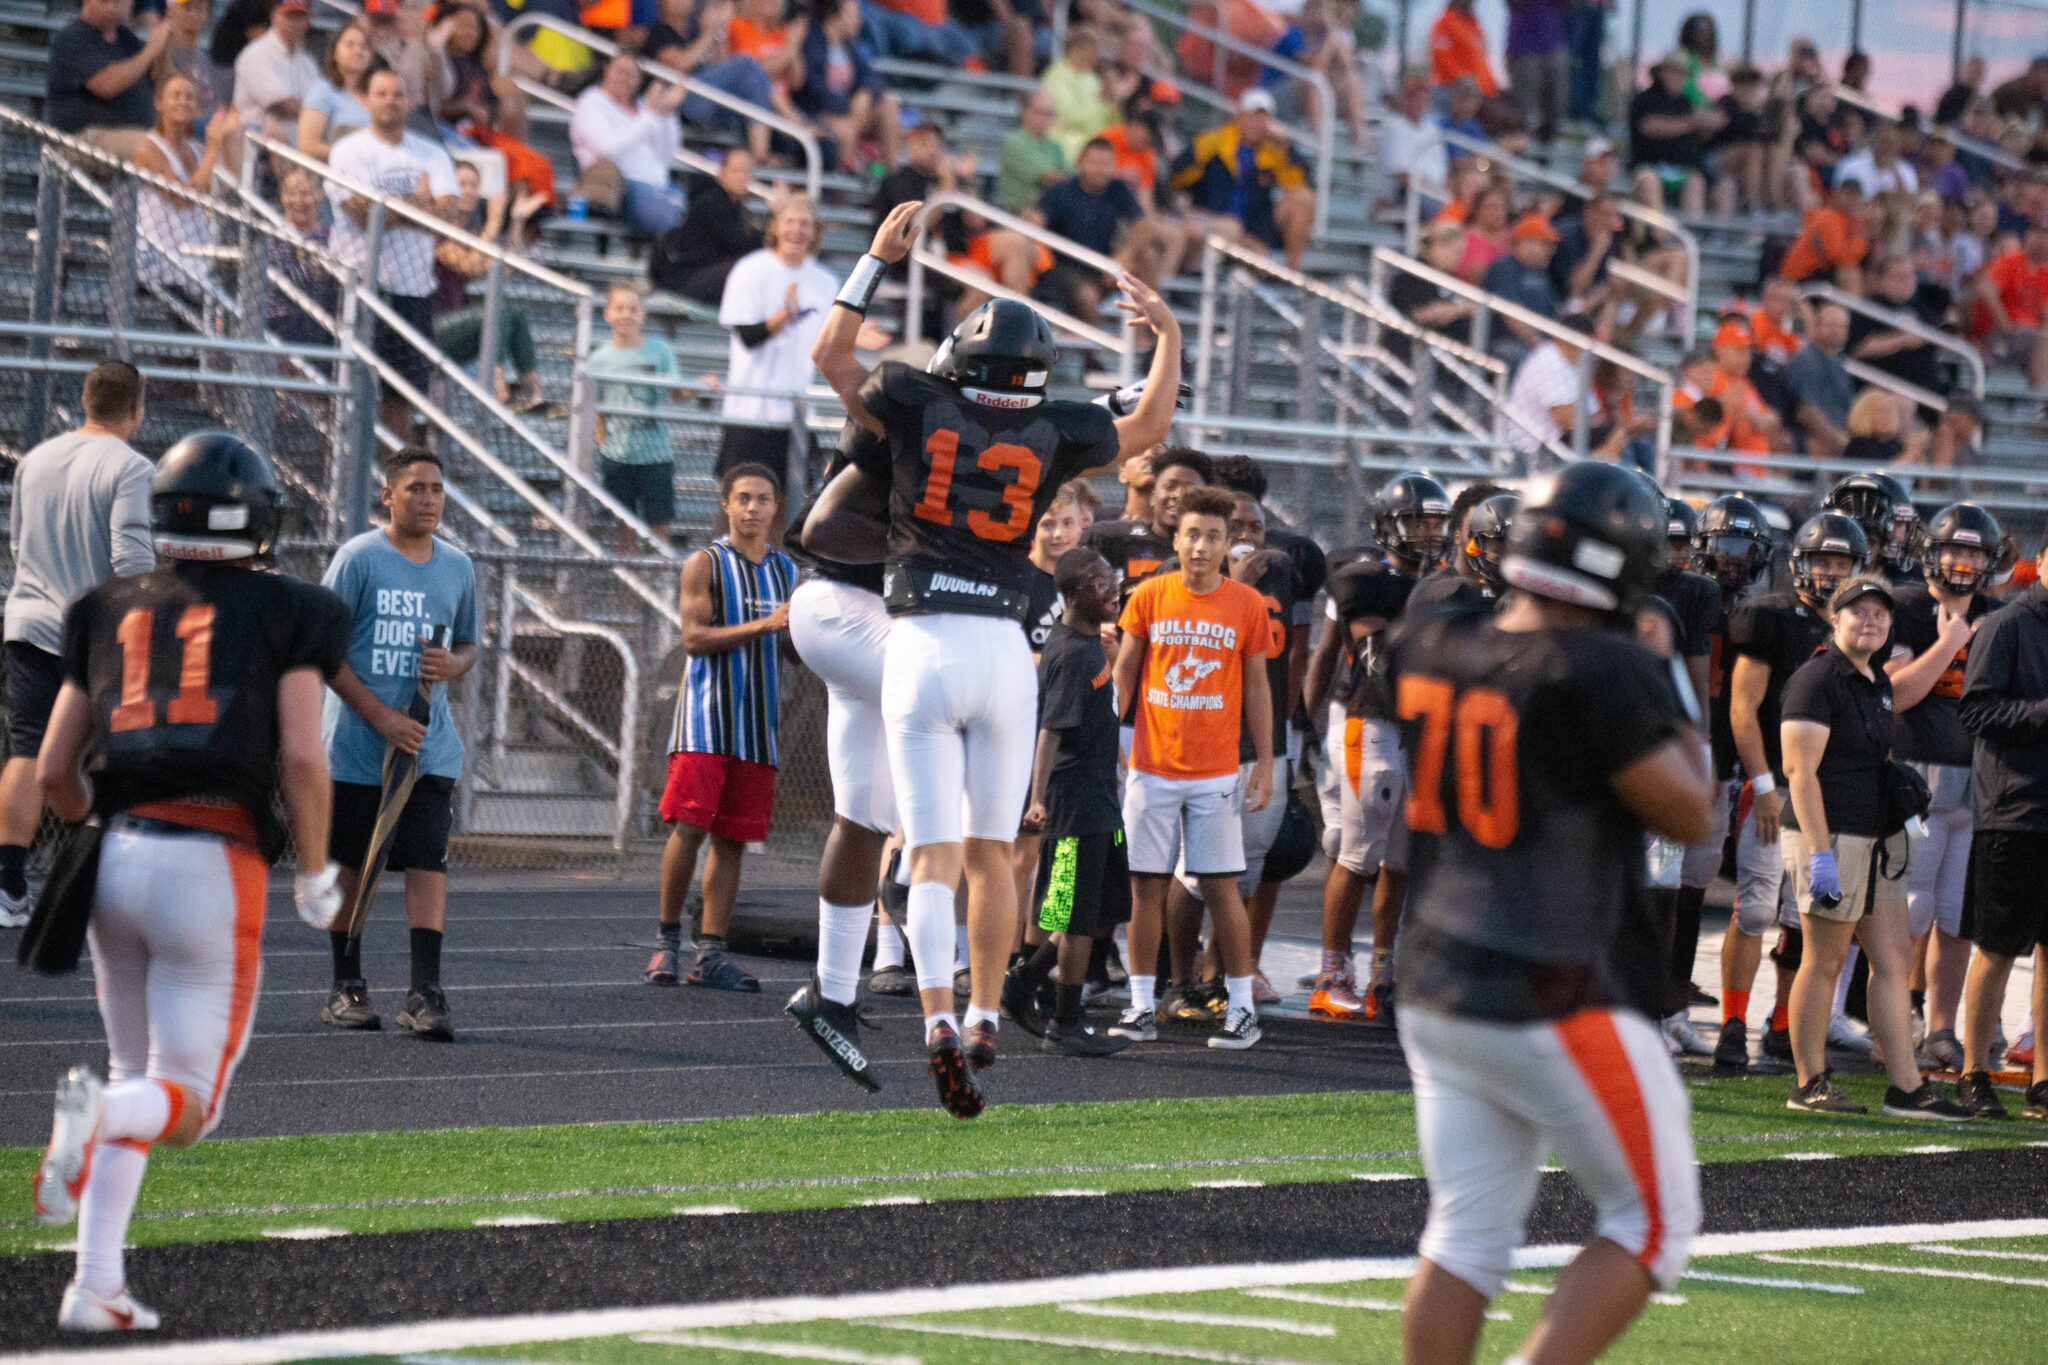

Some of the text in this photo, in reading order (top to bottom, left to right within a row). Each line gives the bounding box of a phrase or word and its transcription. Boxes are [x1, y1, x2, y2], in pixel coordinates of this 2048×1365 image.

[976, 392, 1029, 409] Riddell
[914, 428, 1041, 542] 13
[929, 573, 998, 597] DOUGLAS
[377, 589, 430, 619] BEST.
[374, 619, 416, 648] DOG
[1150, 620, 1236, 650] BULLDOG
[1158, 635, 1221, 650] FOOTBALL
[110, 603, 218, 733] 11
[1147, 687, 1224, 710] STATE CHAMPIONS
[1396, 671, 1520, 849] 70
[813, 1017, 868, 1072] ADIZERO
